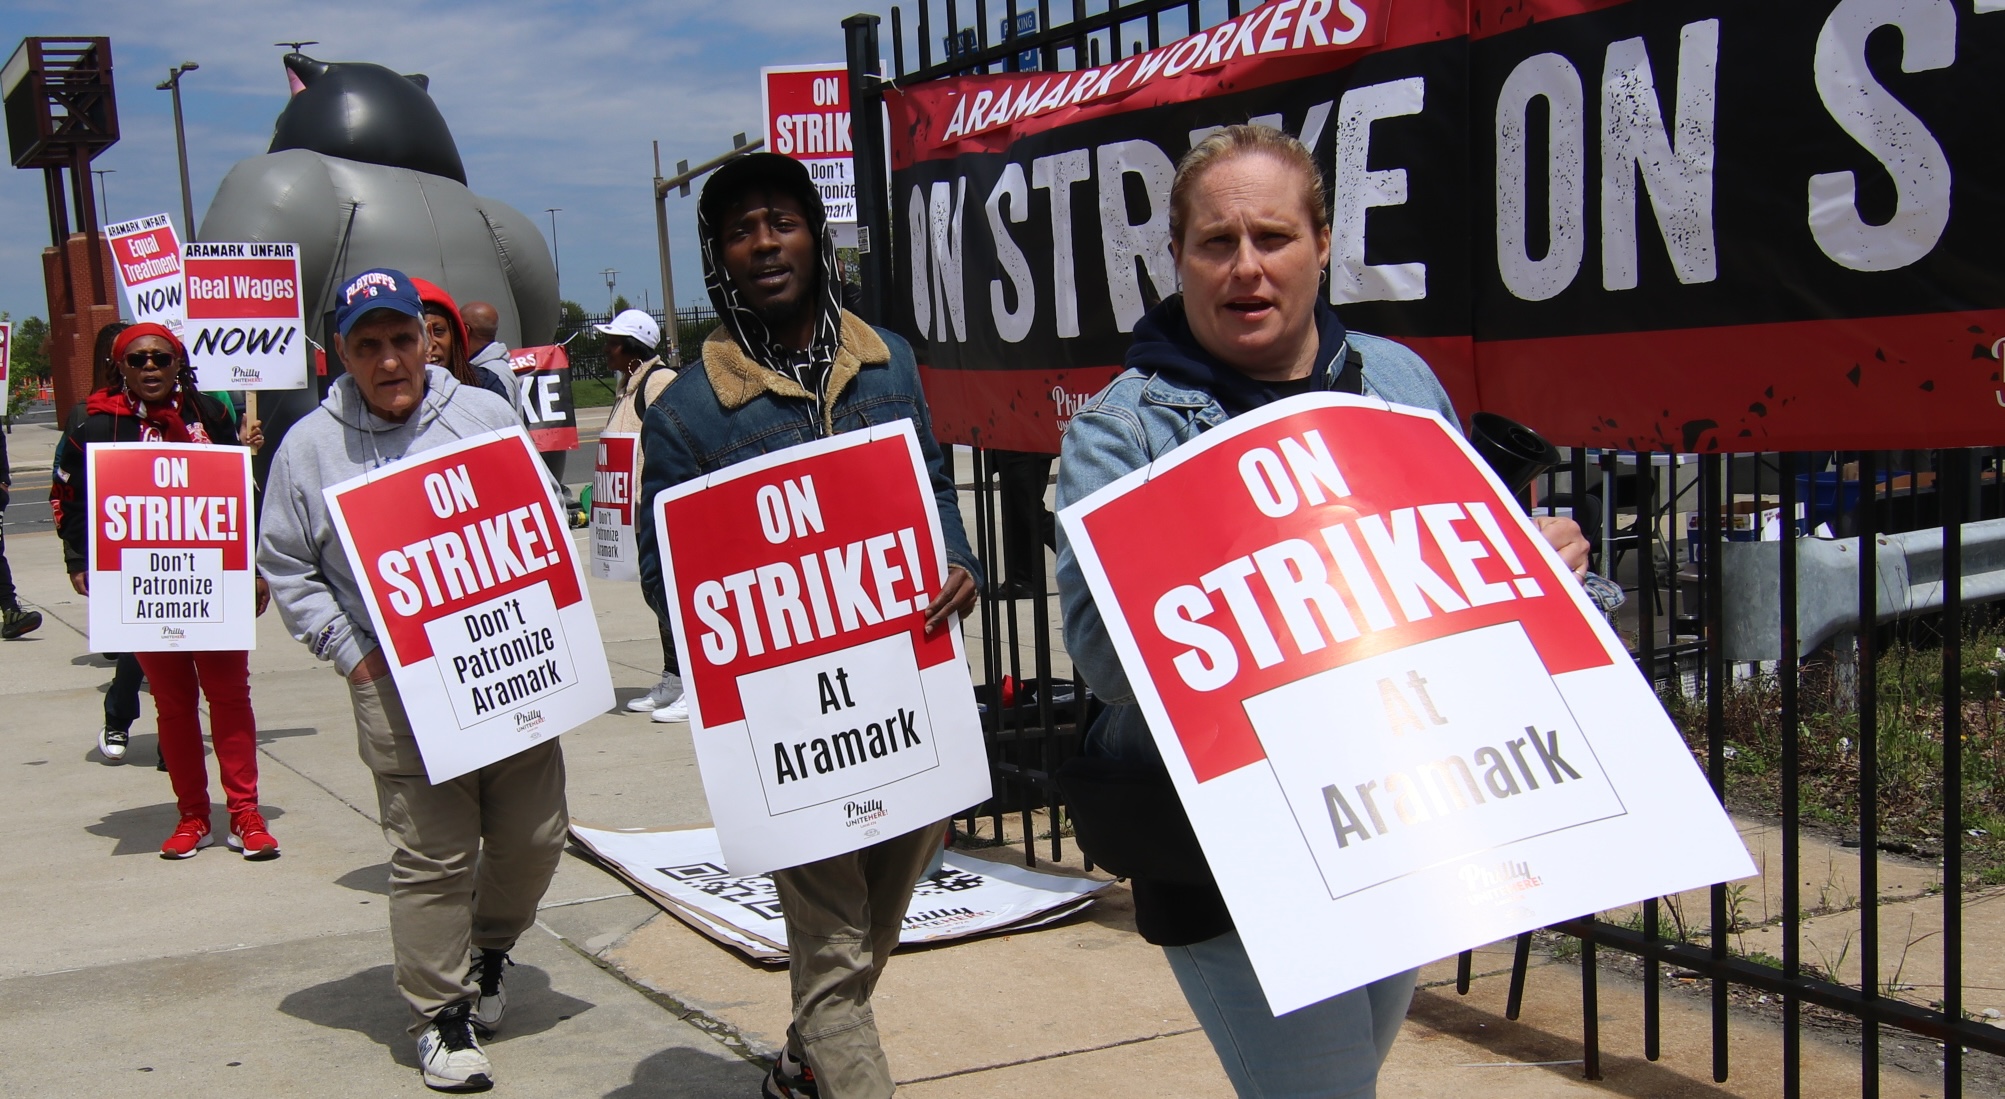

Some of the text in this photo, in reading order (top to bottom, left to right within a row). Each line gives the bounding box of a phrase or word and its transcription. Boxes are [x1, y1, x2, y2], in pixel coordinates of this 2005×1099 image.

[1004, 15, 1033, 35] PKING
[943, 0, 1368, 142] ARAMARK WORKERS
[813, 77, 839, 107] ON
[776, 112, 853, 155] STRIK
[1495, 0, 2005, 301] ON S
[811, 162, 844, 180] Don't
[814, 181, 856, 199] ronize
[825, 202, 854, 218] mark
[909, 77, 1427, 344] ON STRE
[108, 215, 168, 237] ARAMARK UNFAIR
[127, 234, 160, 258] Equal
[186, 245, 294, 257] ARAMARK UNFAIR
[123, 253, 180, 282] Treatment
[189, 276, 294, 301] Real Wages
[345, 272, 397, 305] PLAYOFFS
[192, 326, 297, 356] NOW!
[231, 366, 260, 379] Philly
[1052, 386, 1089, 416] Phil
[154, 457, 189, 488] ON
[1237, 429, 1351, 519] ON
[423, 464, 480, 519] ON
[104, 495, 239, 541] STRIKE!
[755, 474, 825, 545] ON
[150, 552, 195, 572] Don't
[377, 501, 561, 618] STRIKE!
[133, 575, 213, 596] Patronize
[693, 526, 931, 667] STRIKE!
[1153, 502, 1545, 693] STRIKE!
[136, 599, 210, 619] Aramark
[464, 598, 526, 644] Don't
[161, 626, 185, 636] Philly
[453, 626, 555, 684] Patronize
[471, 658, 562, 716] Aramark
[816, 667, 856, 715] At
[513, 710, 542, 726] Philly
[1375, 669, 1449, 737] At
[773, 708, 922, 785] Aramark
[1321, 725, 1583, 849] Aramark
[843, 799, 882, 819] Philly
[845, 809, 888, 828] UNITEHERE!
[902, 907, 974, 924] hilly
